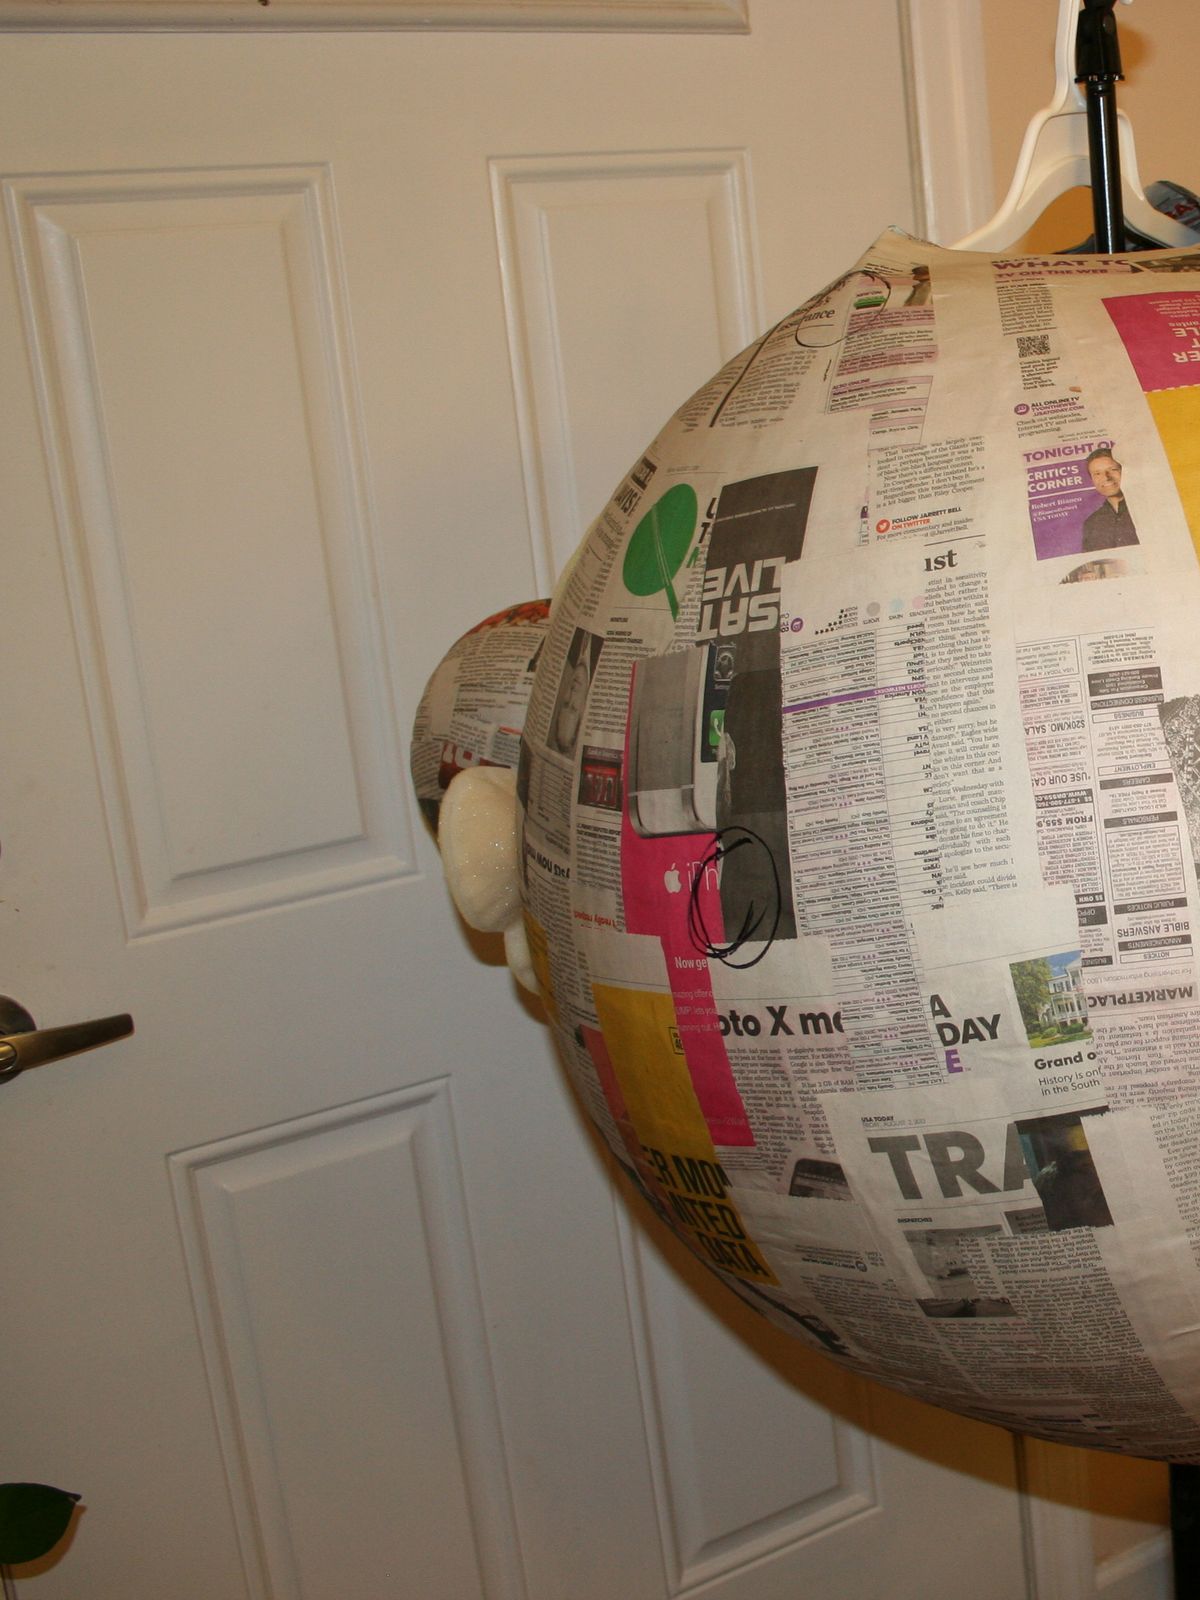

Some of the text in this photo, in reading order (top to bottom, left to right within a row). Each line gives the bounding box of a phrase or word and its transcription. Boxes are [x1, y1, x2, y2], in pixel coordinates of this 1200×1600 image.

[992, 261, 1088, 269] WHAT
[1024, 443, 1094, 462] TONIGHT
[1028, 465, 1079, 481] CRITIC'S
[1028, 476, 1082, 492] CORNER
[1031, 501, 1056, 509] Robert
[892, 514, 919, 524] FOLLOW
[920, 509, 947, 518] JARRETT
[903, 519, 930, 527] TWITTER
[702, 556, 786, 601] LIVE
[695, 592, 780, 641] SAT
[1113, 710, 1144, 720] BUSINESS
[1024, 719, 1085, 736] $20K/MO. SALA
[1114, 762, 1156, 773] EMPLOYMENT
[1049, 775, 1067, 785] OUR
[1037, 815, 1093, 828] FROM $55,9
[1127, 899, 1175, 911] PUBLIC NOTICES
[1116, 921, 1190, 938] BIBLE ANSWERS
[675, 957, 694, 969] Now
[1143, 951, 1170, 960] NOTICES
[1086, 985, 1193, 1008] MARKETPLAC
[930, 994, 952, 1019] A
[766, 1005, 794, 1037] X
[935, 1014, 1001, 1047] DAY
[945, 1049, 963, 1074] E
[1034, 1051, 1083, 1070] Grand
[1039, 1075, 1072, 1085] History
[1041, 1079, 1100, 1096] in the South
